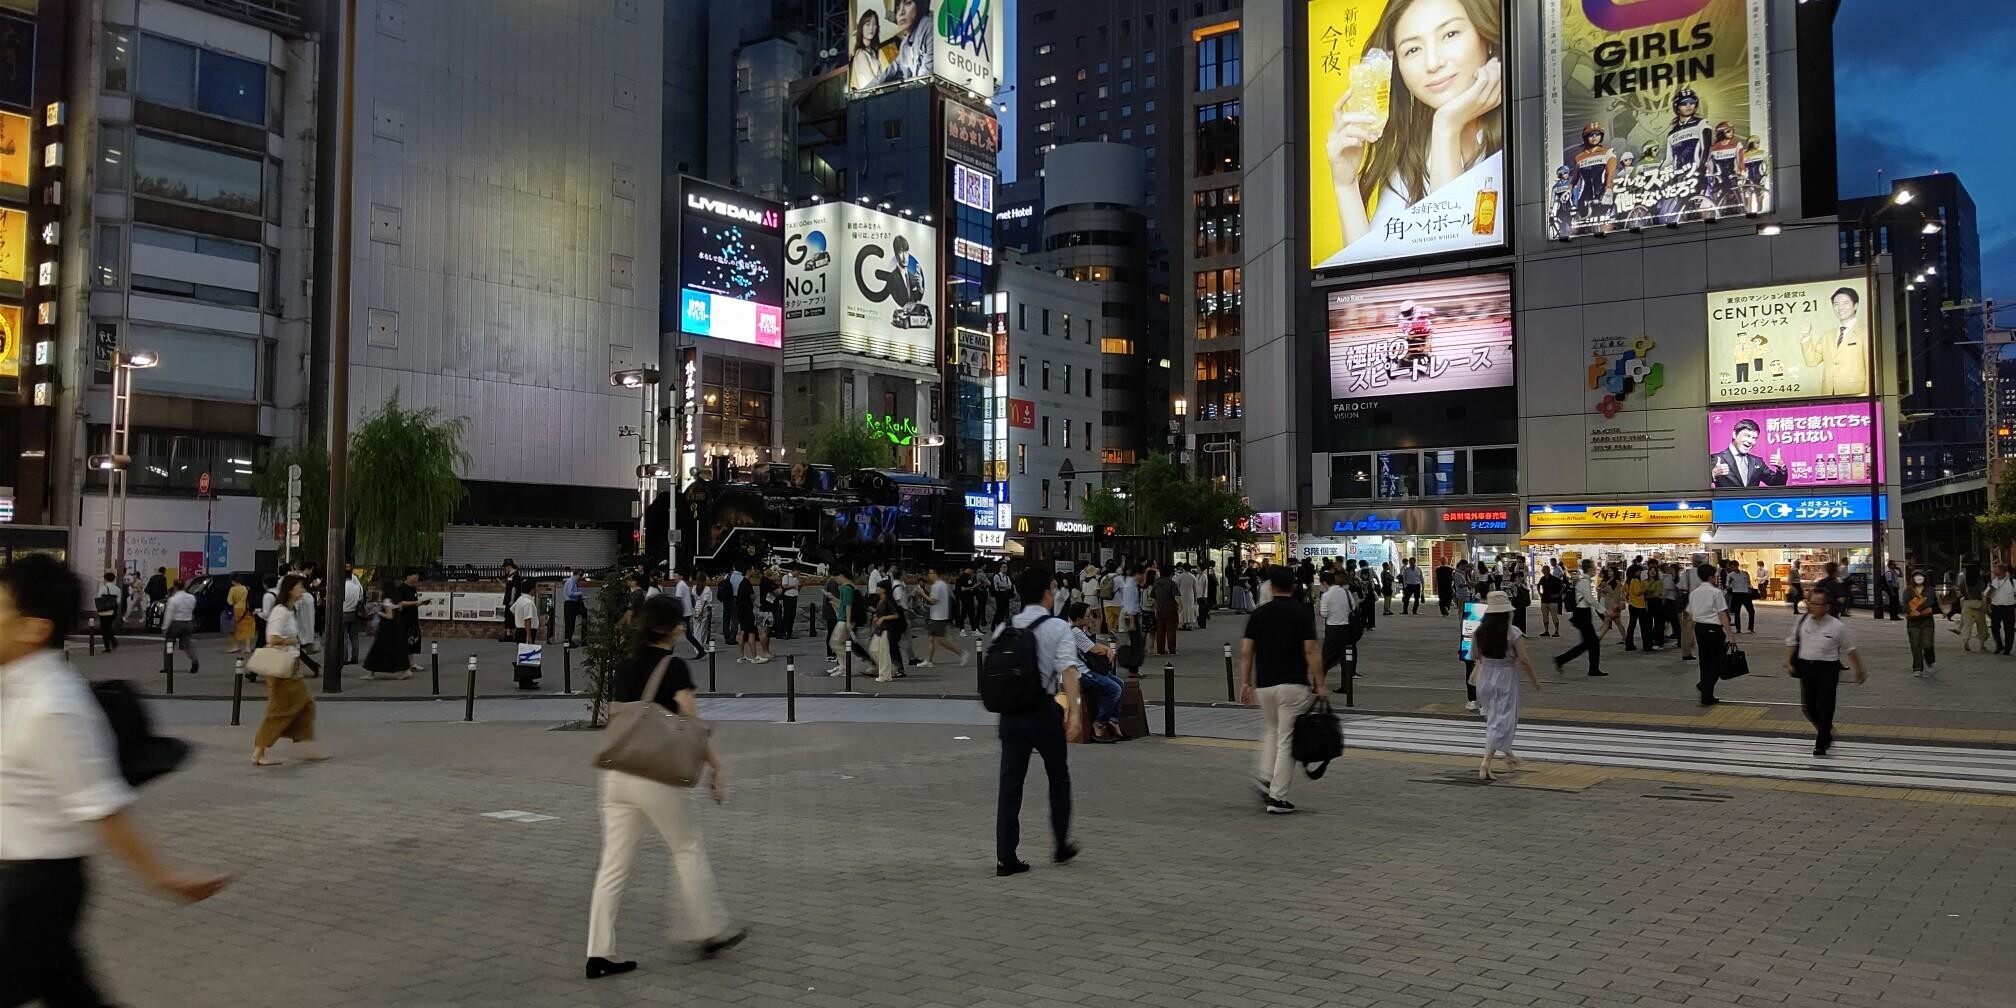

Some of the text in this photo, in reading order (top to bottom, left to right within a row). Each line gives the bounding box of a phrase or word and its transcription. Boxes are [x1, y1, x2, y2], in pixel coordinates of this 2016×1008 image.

[1344, 7, 1358, 47] 新橋で
[1320, 26, 1343, 76] 今夜、
[1594, 22, 1713, 67] GIRLS
[947, 51, 989, 79] GROUP
[1594, 54, 1714, 99] KEIRIN
[1012, 206, 1032, 218] Hotel
[1384, 213, 1477, 242] 角ハイボール
[786, 272, 826, 298] No.1
[785, 297, 826, 309] タクシーアプリ
[1336, 295, 1350, 303] Auto
[1727, 290, 1806, 304] 東京のマンション経営は
[1712, 299, 1818, 321] CENTURY 21
[1741, 317, 1789, 329] レイシャス
[1346, 337, 1409, 371] 極限の
[1349, 346, 1493, 393] スピードレース
[1720, 383, 1800, 397] 0120-922-442
[1334, 402, 1379, 412] FARO CITY
[1334, 412, 1359, 420] VISION
[1766, 414, 1871, 433] 新橋で疲れてちゃ
[1767, 430, 1834, 445] いられない
[1795, 506, 1854, 519] コンタクト
[1333, 514, 1402, 532] LA PISTA
